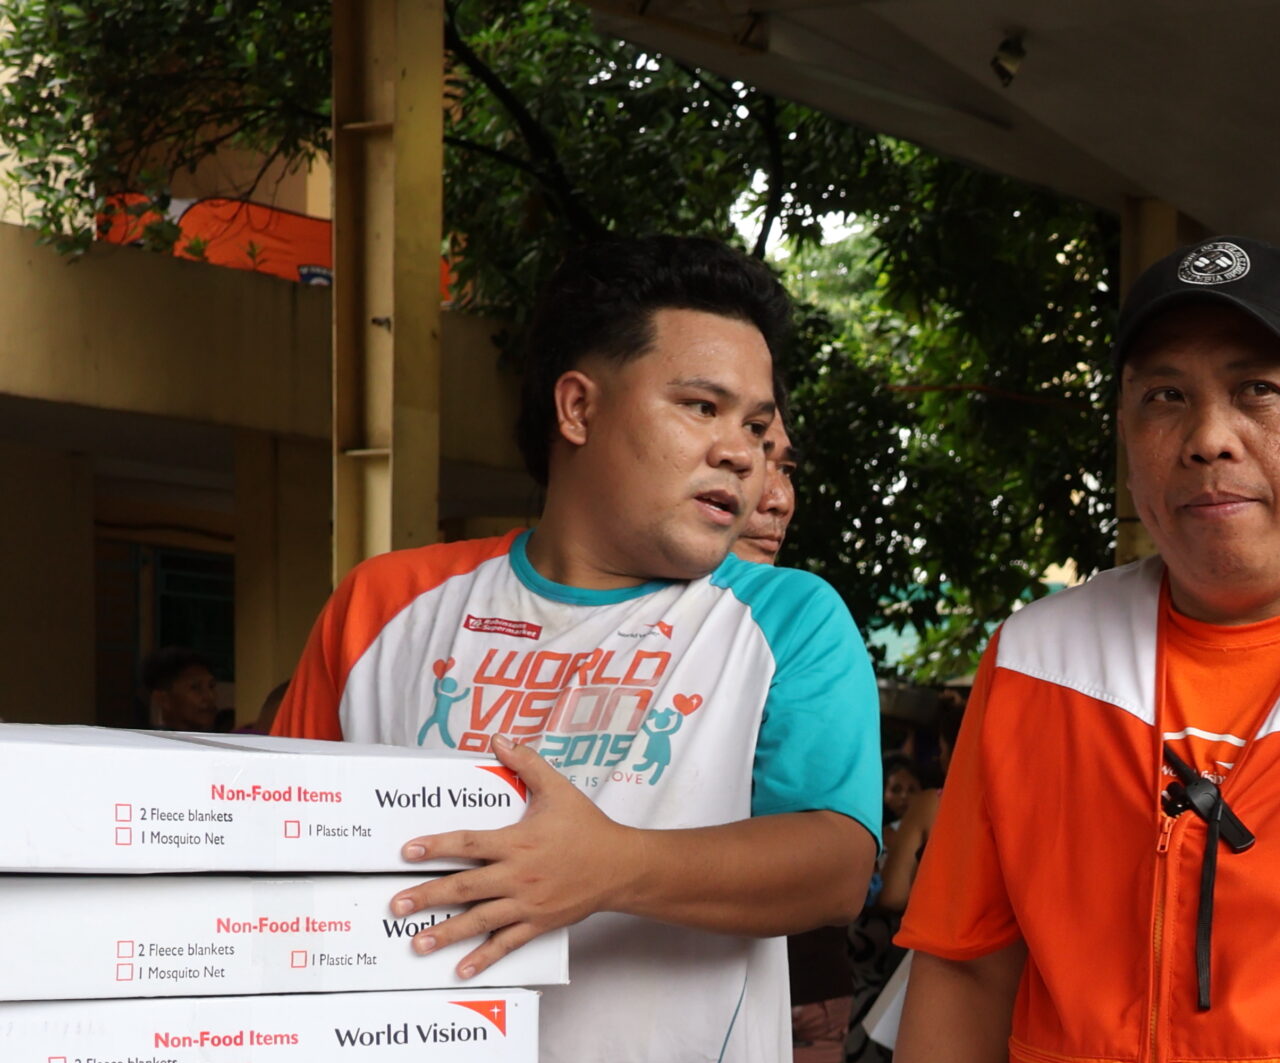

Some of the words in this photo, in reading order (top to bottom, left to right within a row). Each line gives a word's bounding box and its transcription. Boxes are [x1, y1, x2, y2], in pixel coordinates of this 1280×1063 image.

[473, 648, 671, 689] WORLD
[470, 686, 653, 734] VISION
[585, 776, 598, 787] IS
[604, 771, 642, 784] OVE
[211, 784, 292, 802] Non-Food
[297, 786, 342, 803] Items
[375, 786, 440, 808] World
[448, 785, 512, 807] Vision
[139, 806, 148, 821] 2
[151, 808, 184, 821] Fleece
[188, 809, 233, 822] blankets
[316, 824, 348, 837] Plastic
[352, 825, 371, 837] Mat
[150, 831, 201, 848] Mosquito
[205, 832, 224, 845] Net
[217, 917, 300, 933] Non-Food
[305, 916, 351, 932] Items
[383, 914, 450, 938] Worl
[137, 942, 146, 958] 2
[149, 943, 184, 956] Fleece
[188, 943, 235, 956] blankets
[319, 953, 352, 966] Plastic
[357, 953, 376, 965] Mat
[148, 967, 200, 982] Mosquito
[204, 965, 225, 978] Net
[154, 1030, 243, 1048] Non-Food
[250, 1030, 298, 1045] Items
[335, 1023, 408, 1047] World
[416, 1021, 488, 1043] Vision
